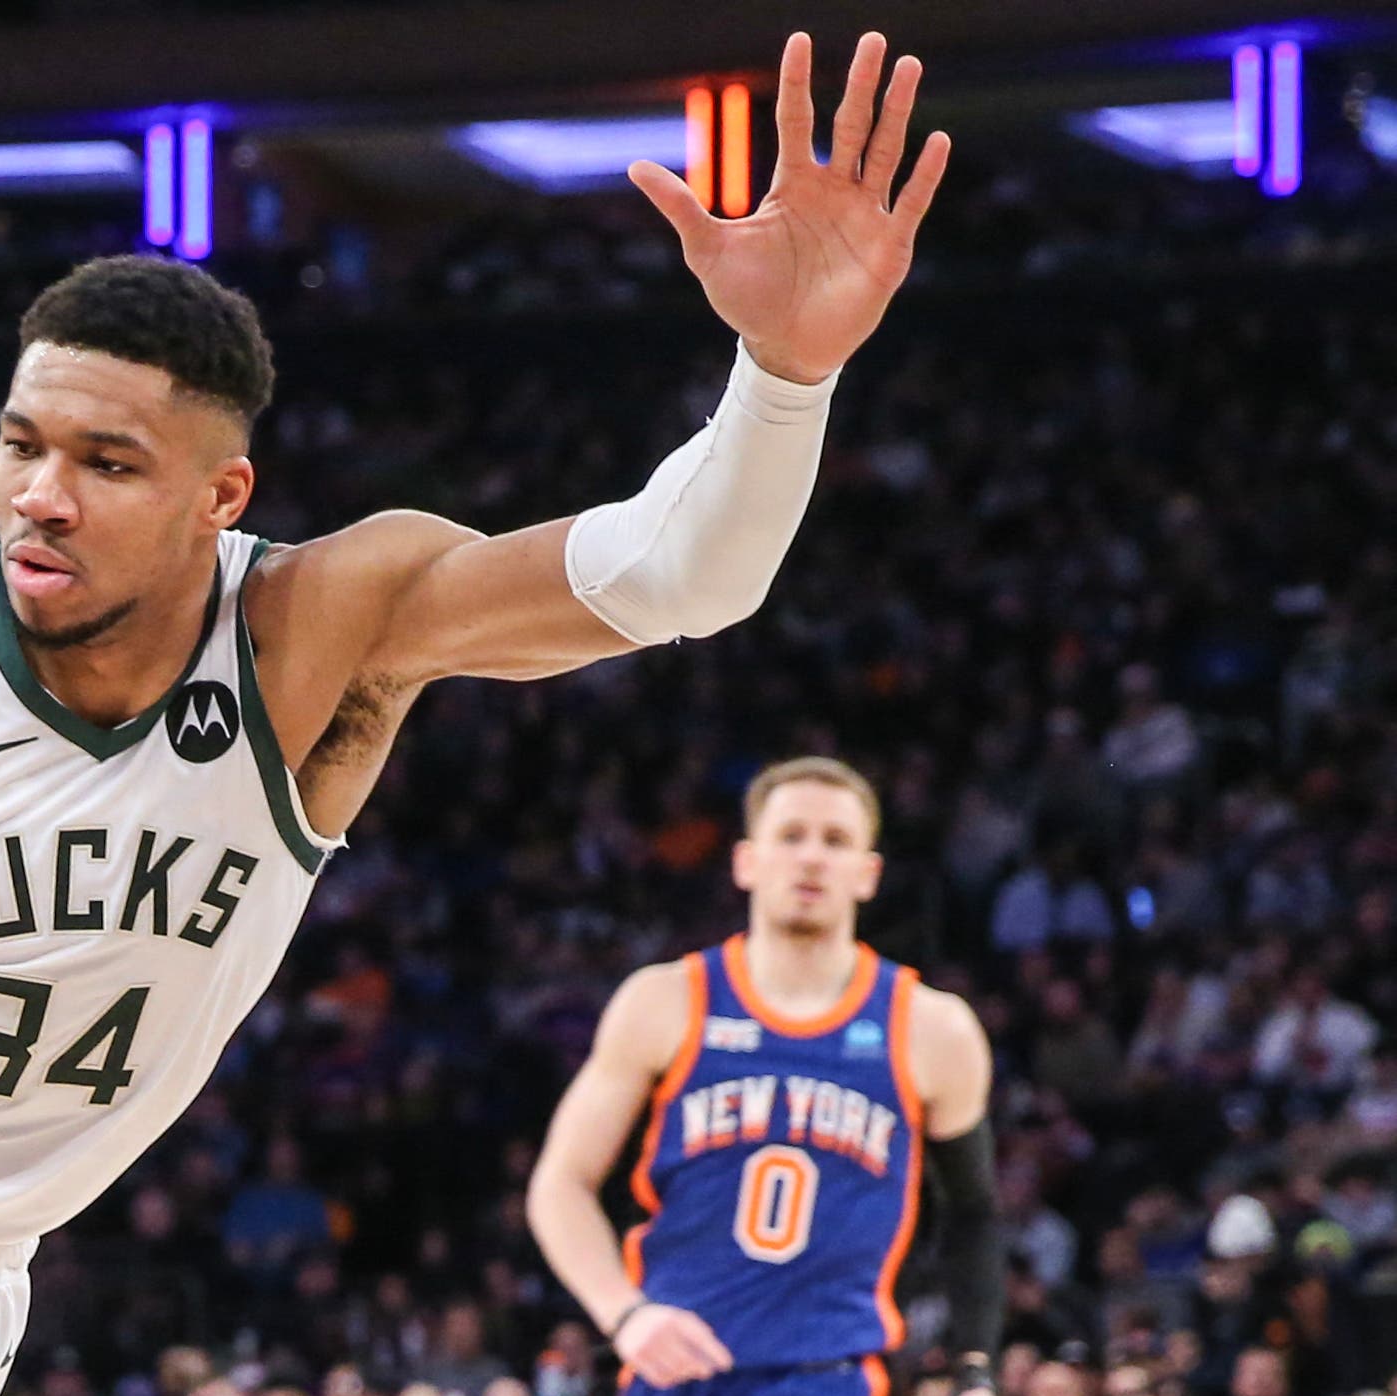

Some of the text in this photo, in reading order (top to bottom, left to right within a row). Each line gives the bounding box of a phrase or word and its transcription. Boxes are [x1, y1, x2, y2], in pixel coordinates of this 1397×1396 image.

[682, 1073, 896, 1177] NEW YORK
[733, 1144, 819, 1265] 0
